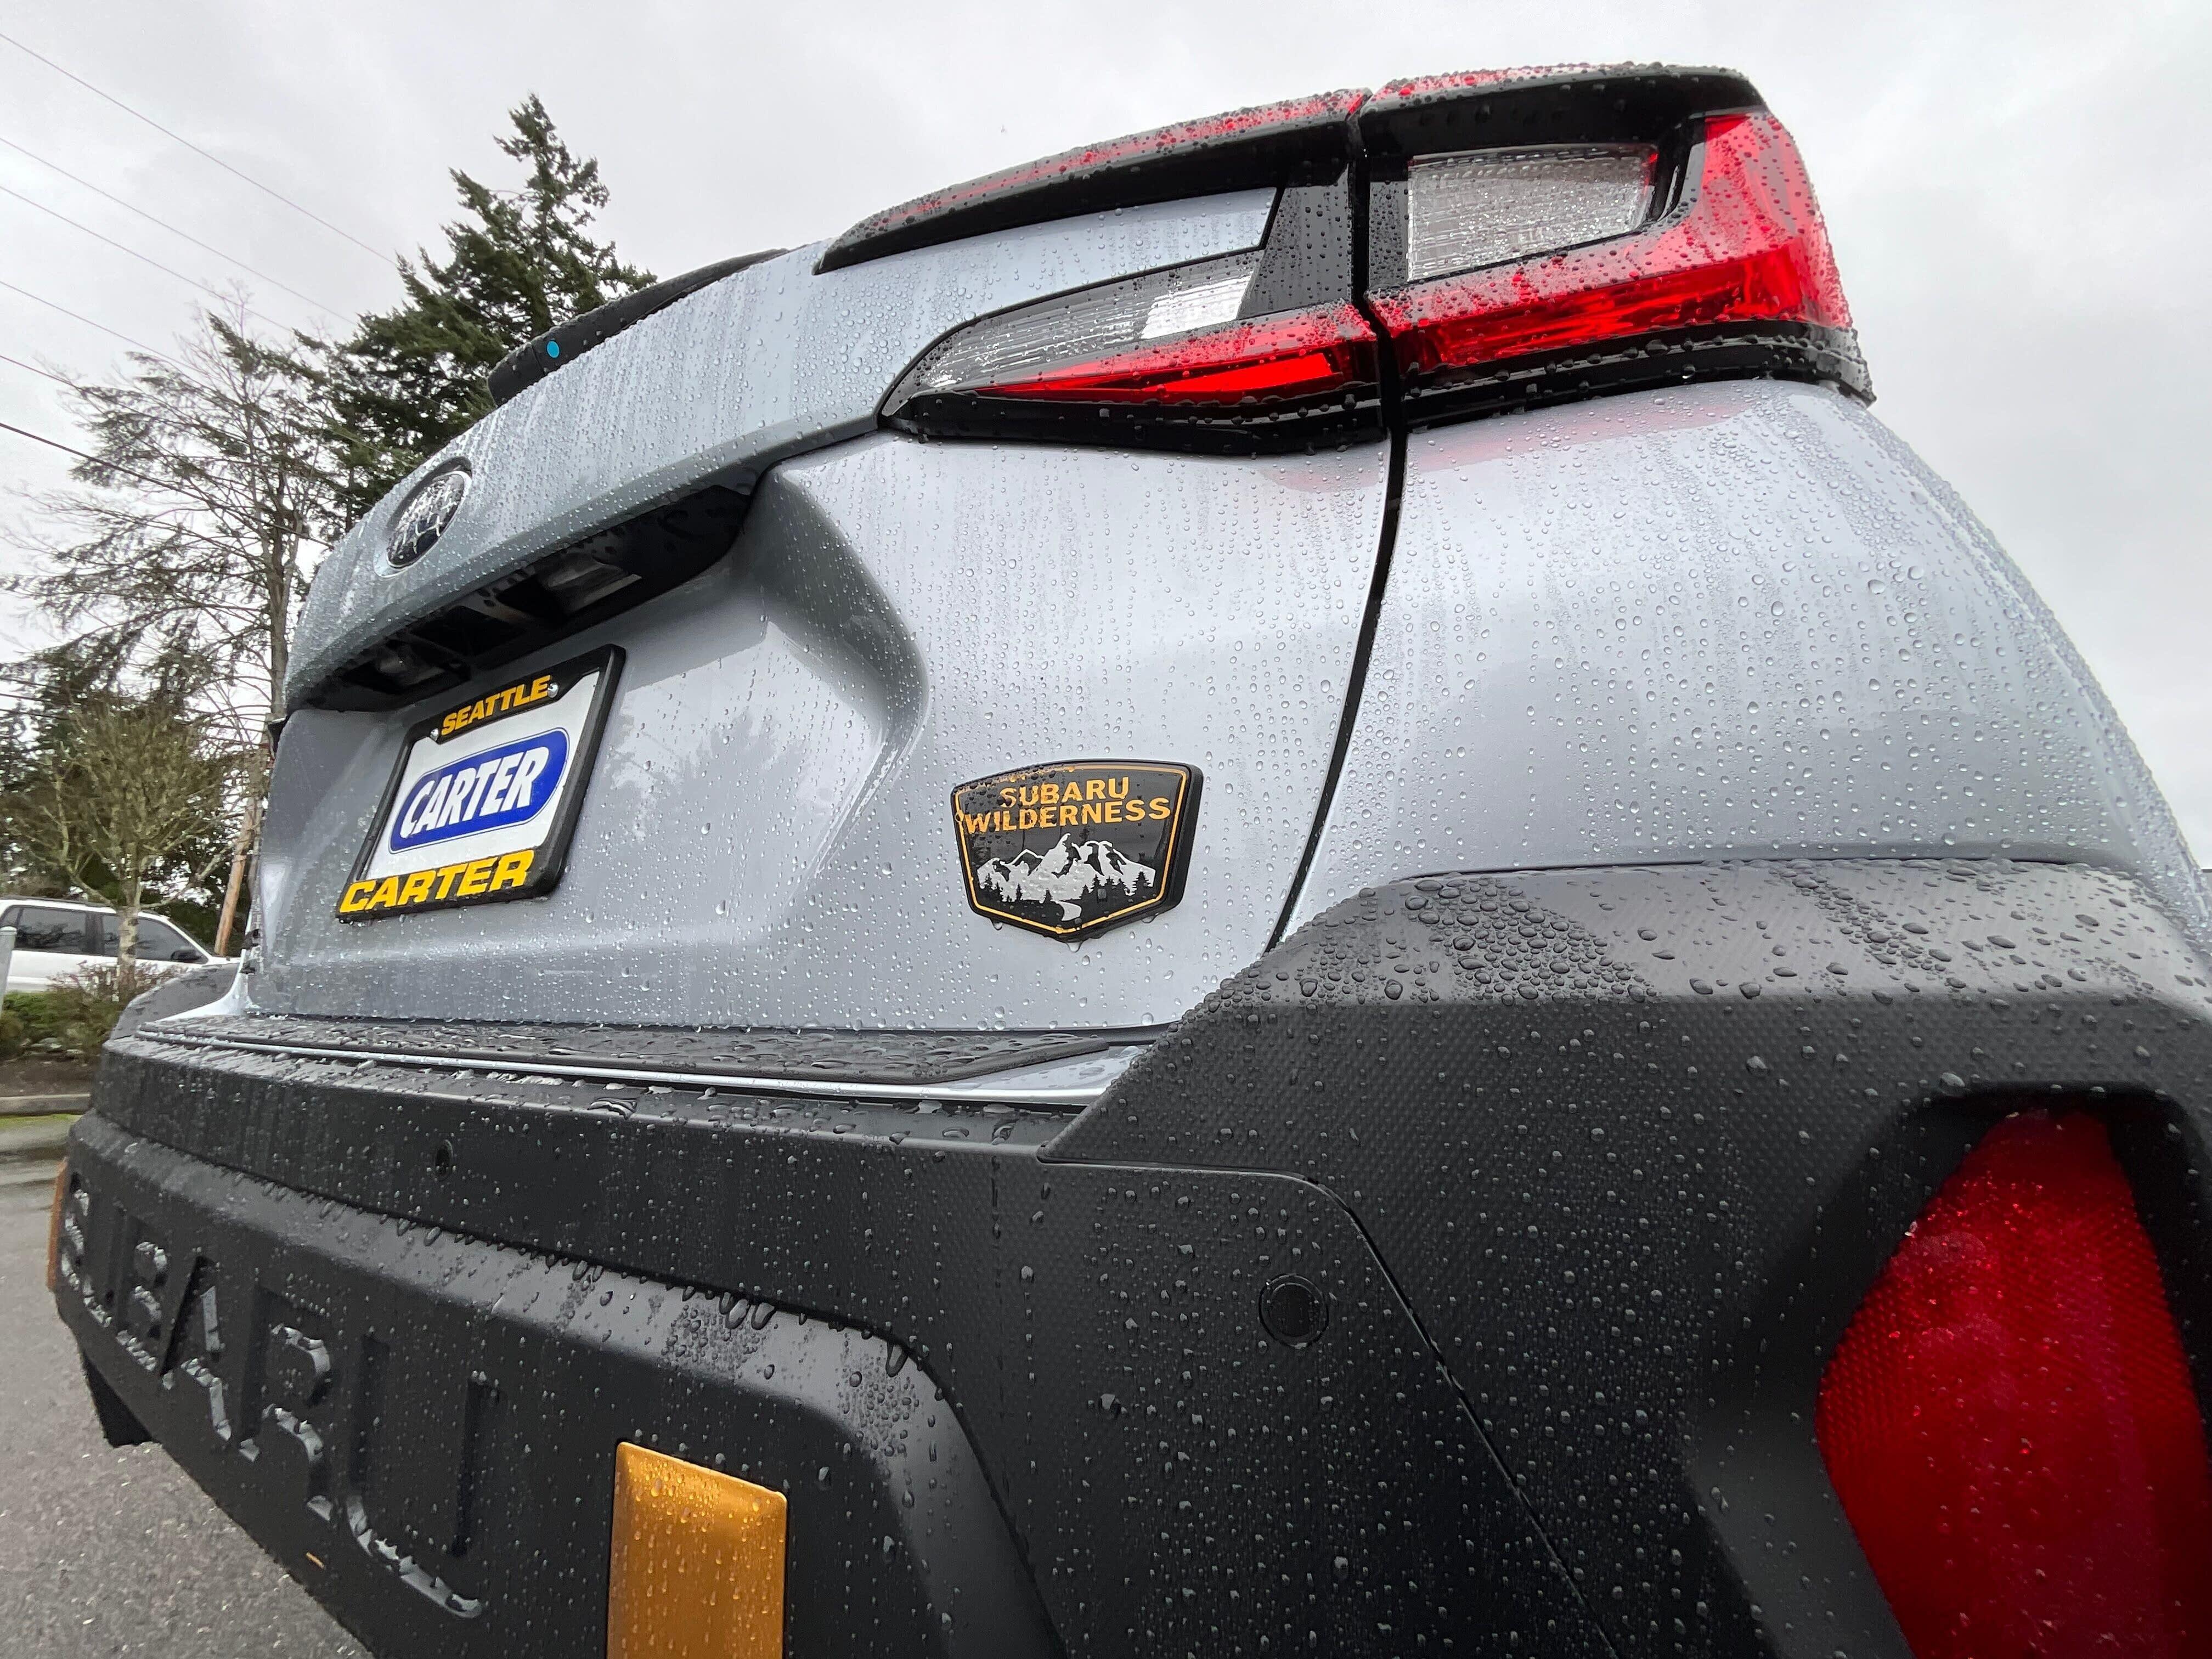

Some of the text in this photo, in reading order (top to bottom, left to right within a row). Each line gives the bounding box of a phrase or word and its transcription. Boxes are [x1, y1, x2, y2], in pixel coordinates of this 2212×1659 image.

[441, 675, 551, 736] SEATTLE
[399, 746, 549, 838] CARTER
[964, 797, 1172, 834] WILDERNESS
[1000, 776, 1130, 808] SUBARU
[339, 849, 535, 913] CARTER
